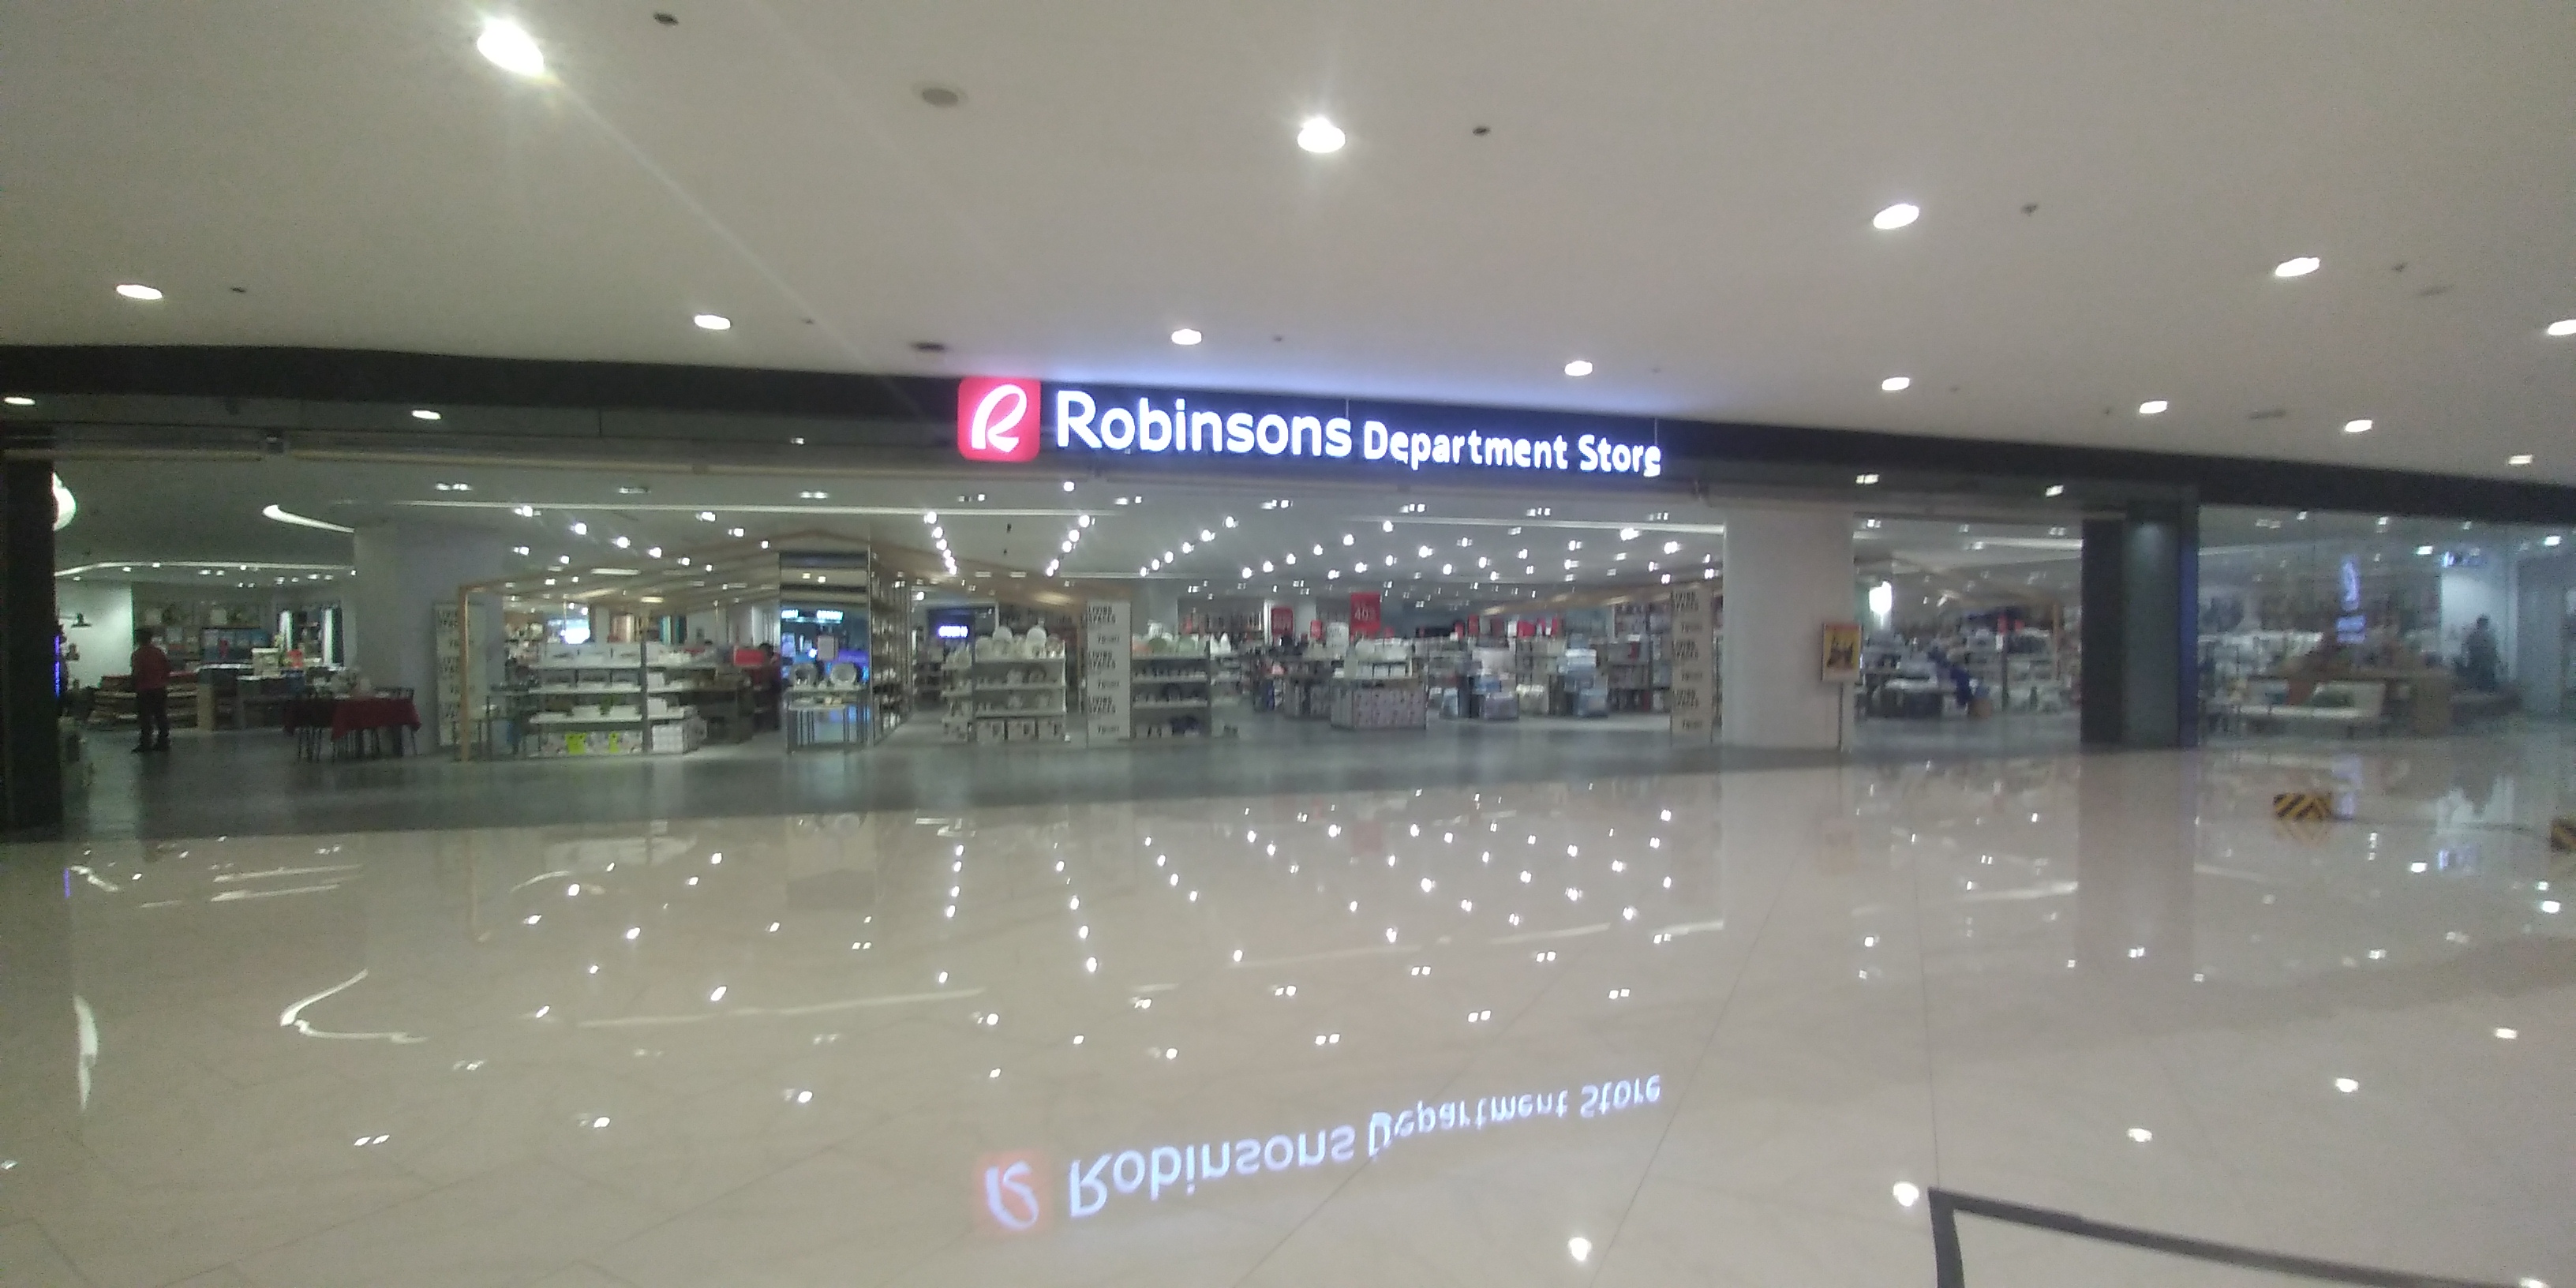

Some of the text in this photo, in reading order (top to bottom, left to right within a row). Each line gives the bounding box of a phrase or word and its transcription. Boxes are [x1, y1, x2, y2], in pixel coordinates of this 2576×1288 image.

[1057, 389, 1353, 458] Robinsons
[1364, 420, 1568, 470] Department
[1578, 434, 1661, 477] Store
